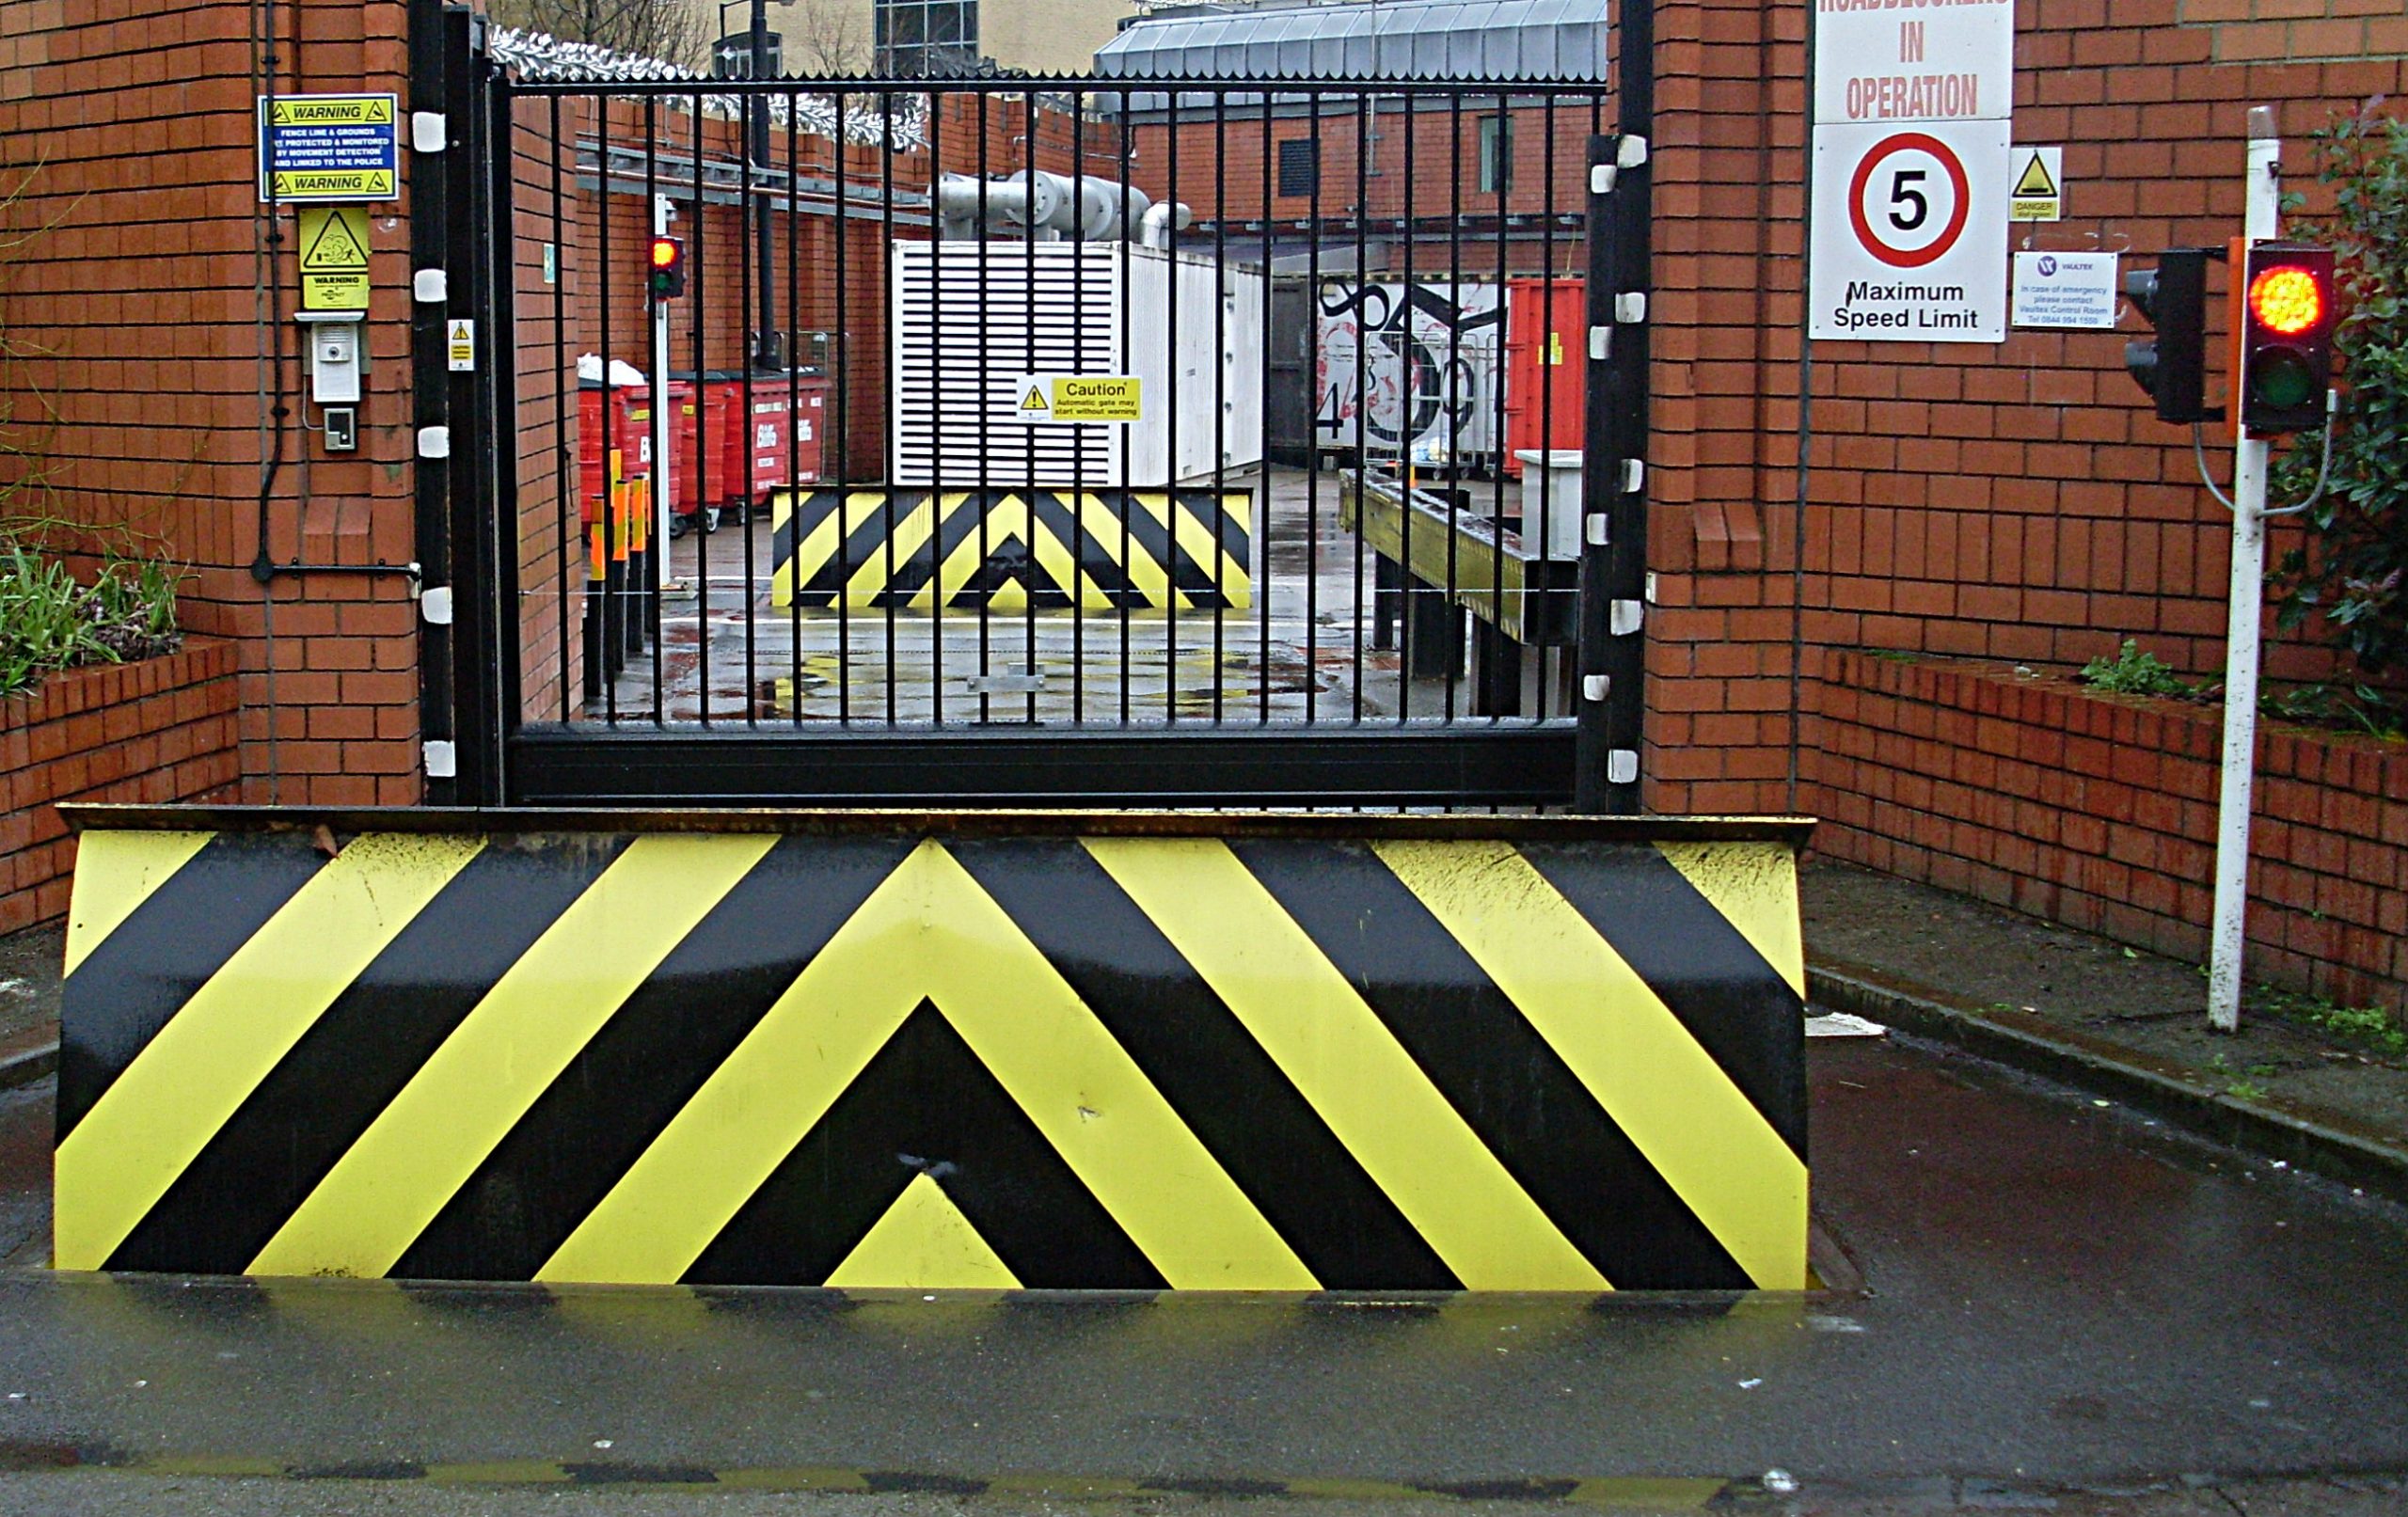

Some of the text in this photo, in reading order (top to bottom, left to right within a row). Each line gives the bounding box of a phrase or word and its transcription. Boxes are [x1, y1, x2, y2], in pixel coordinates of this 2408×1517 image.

[1899, 21, 1924, 63] IN
[1846, 73, 1977, 119] OPERATION
[293, 106, 361, 119] WARNING
[280, 129, 308, 137] FENCE
[336, 128, 376, 136] GROUNDS
[341, 137, 389, 146] MONITORED
[289, 149, 334, 157] MOVEMENT
[335, 148, 381, 156] DETECTION
[293, 159, 322, 167] LINKED
[354, 157, 384, 166] POLICE
[294, 177, 362, 189] WARNING
[1889, 170, 1927, 230] 5
[2016, 202, 2052, 211] DANGER
[1848, 281, 1964, 301] Maximum
[2062, 287, 2107, 295] emergency
[1833, 308, 1978, 331] Speed Limit
[1066, 383, 1126, 396] Caution
